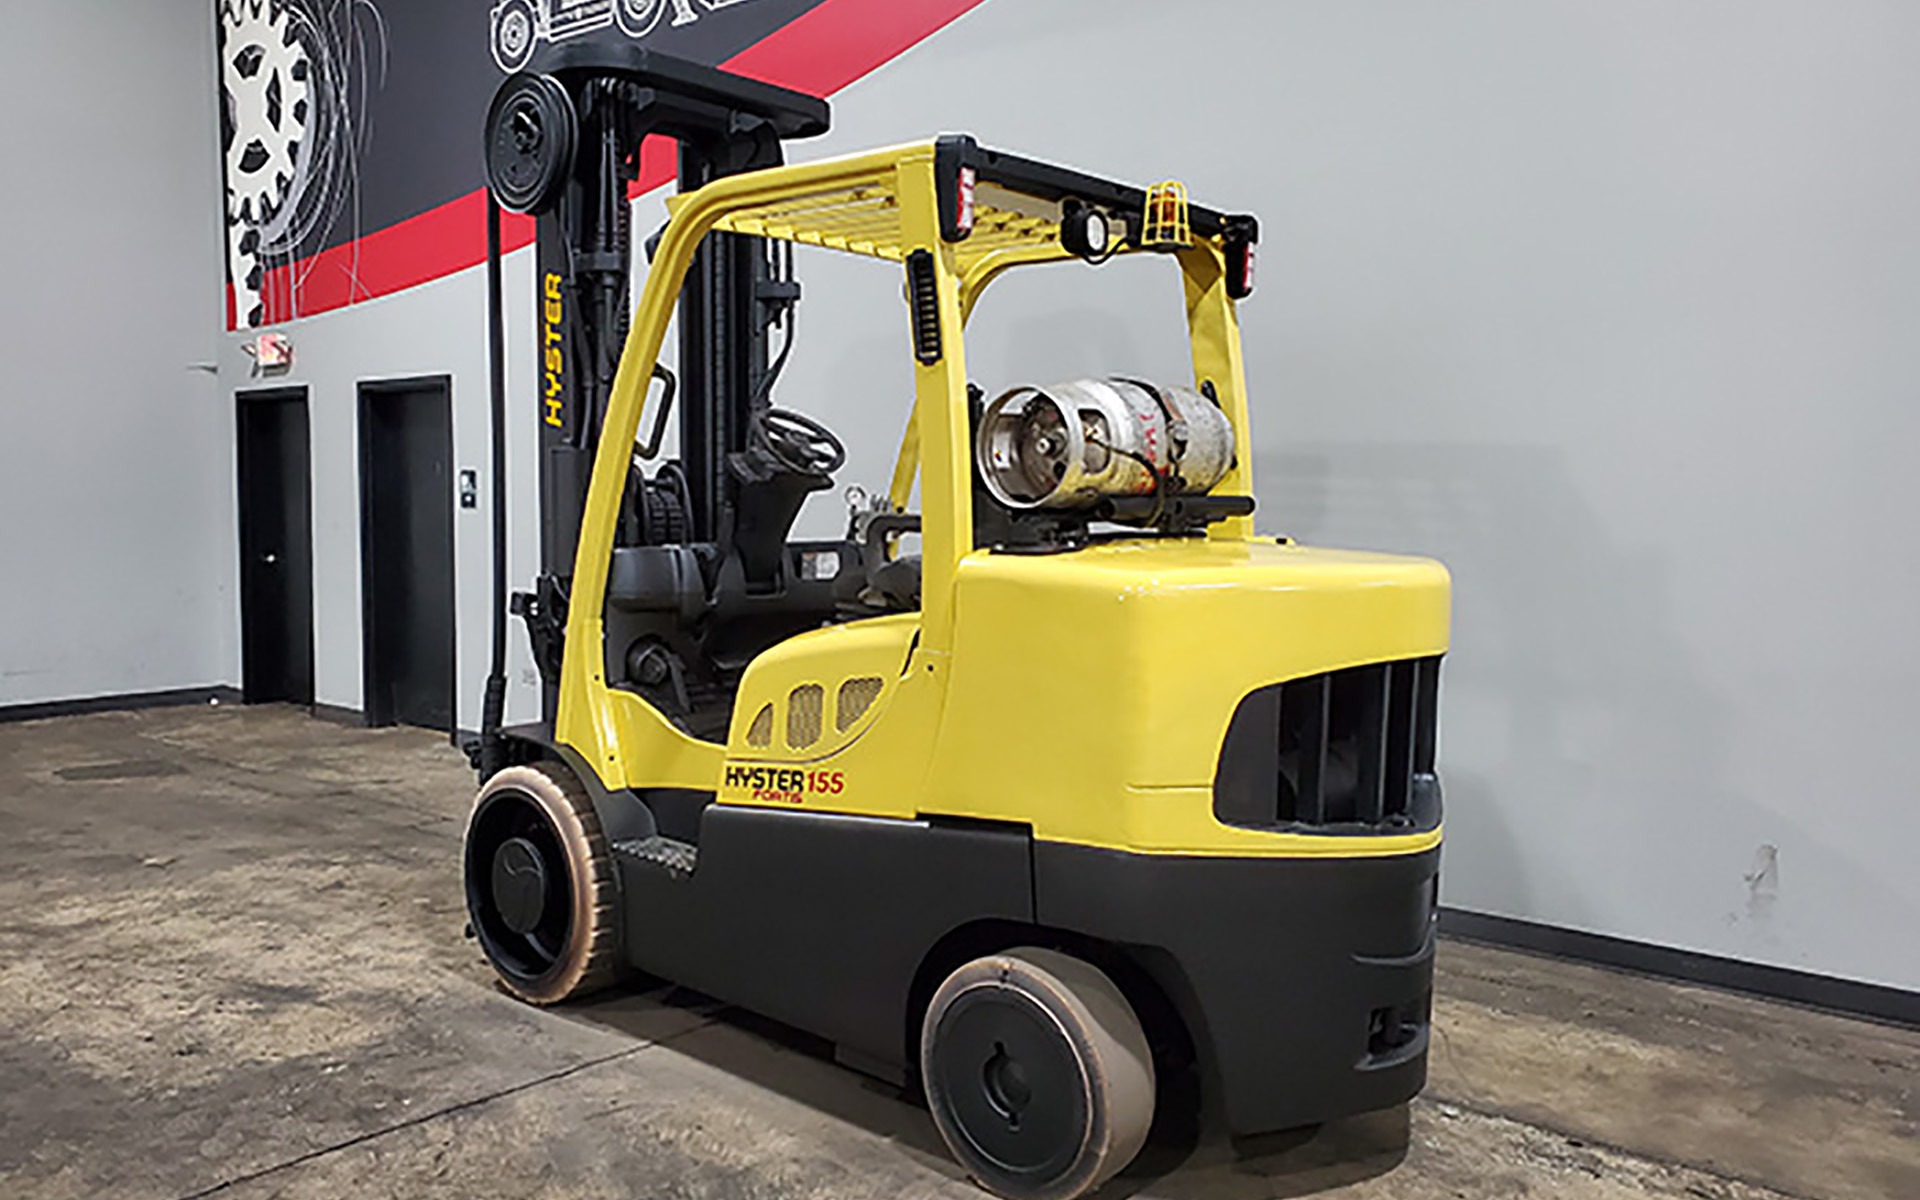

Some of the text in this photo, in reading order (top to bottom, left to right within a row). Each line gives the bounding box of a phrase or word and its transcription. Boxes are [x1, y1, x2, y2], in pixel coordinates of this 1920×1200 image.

[545, 273, 562, 427] HYSTER
[725, 766, 844, 794] HYSTER 155
